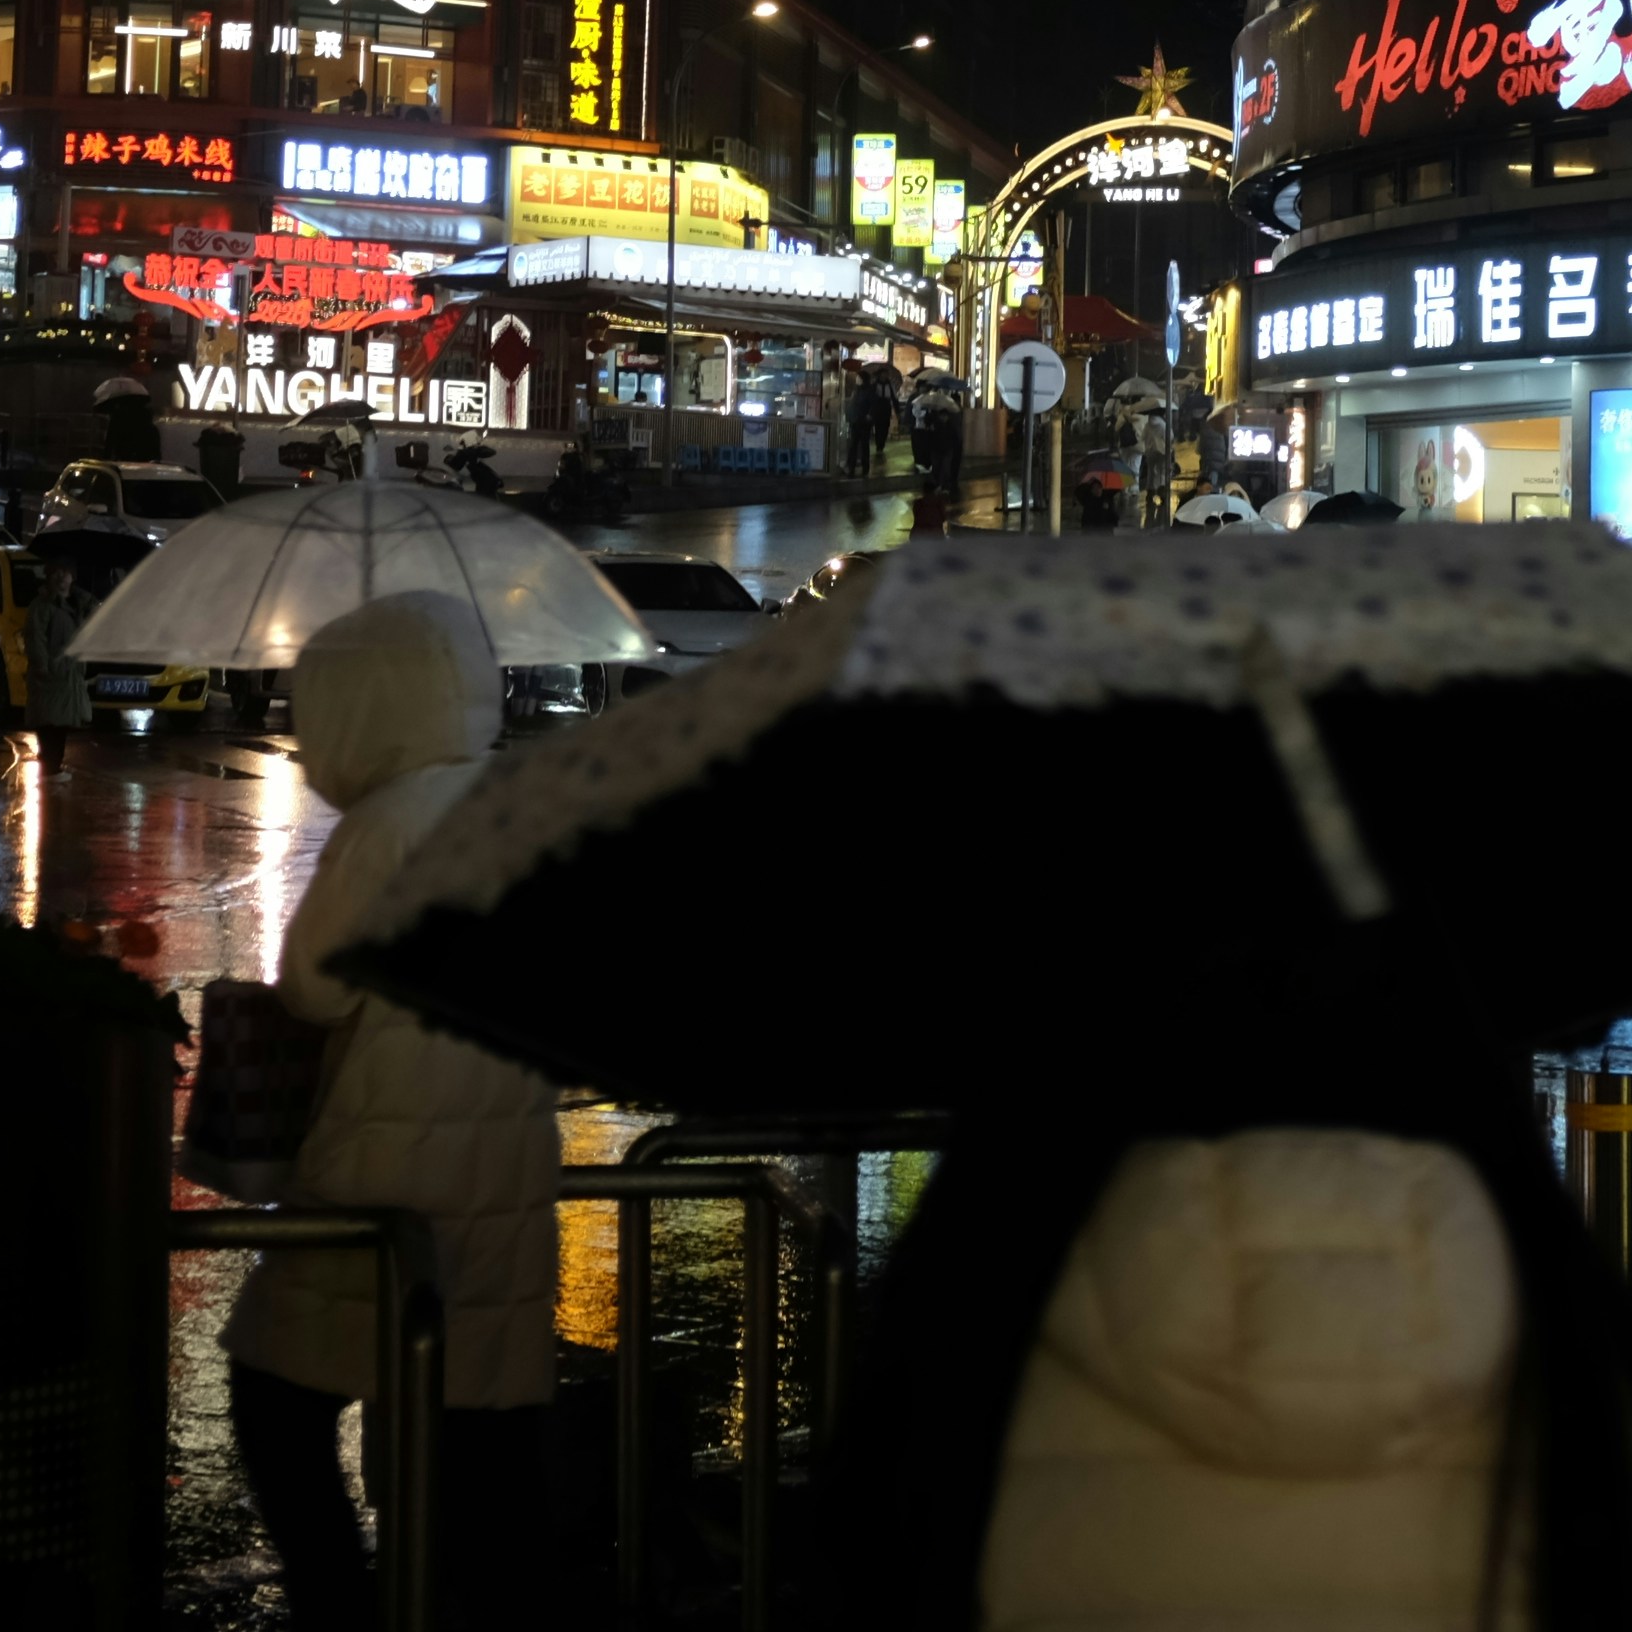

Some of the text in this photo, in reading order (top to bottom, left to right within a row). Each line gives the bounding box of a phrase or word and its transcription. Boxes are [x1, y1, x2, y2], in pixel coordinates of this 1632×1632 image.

[221, 21, 342, 58] 新川菜
[80, 133, 233, 170] 辣子鸡米线
[1087, 137, 1191, 186] 洋河里
[901, 175, 928, 195] 59
[1103, 188, 1143, 202] YANG
[246, 332, 395, 374] 洋河里
[177, 363, 440, 424] YANGHELI
